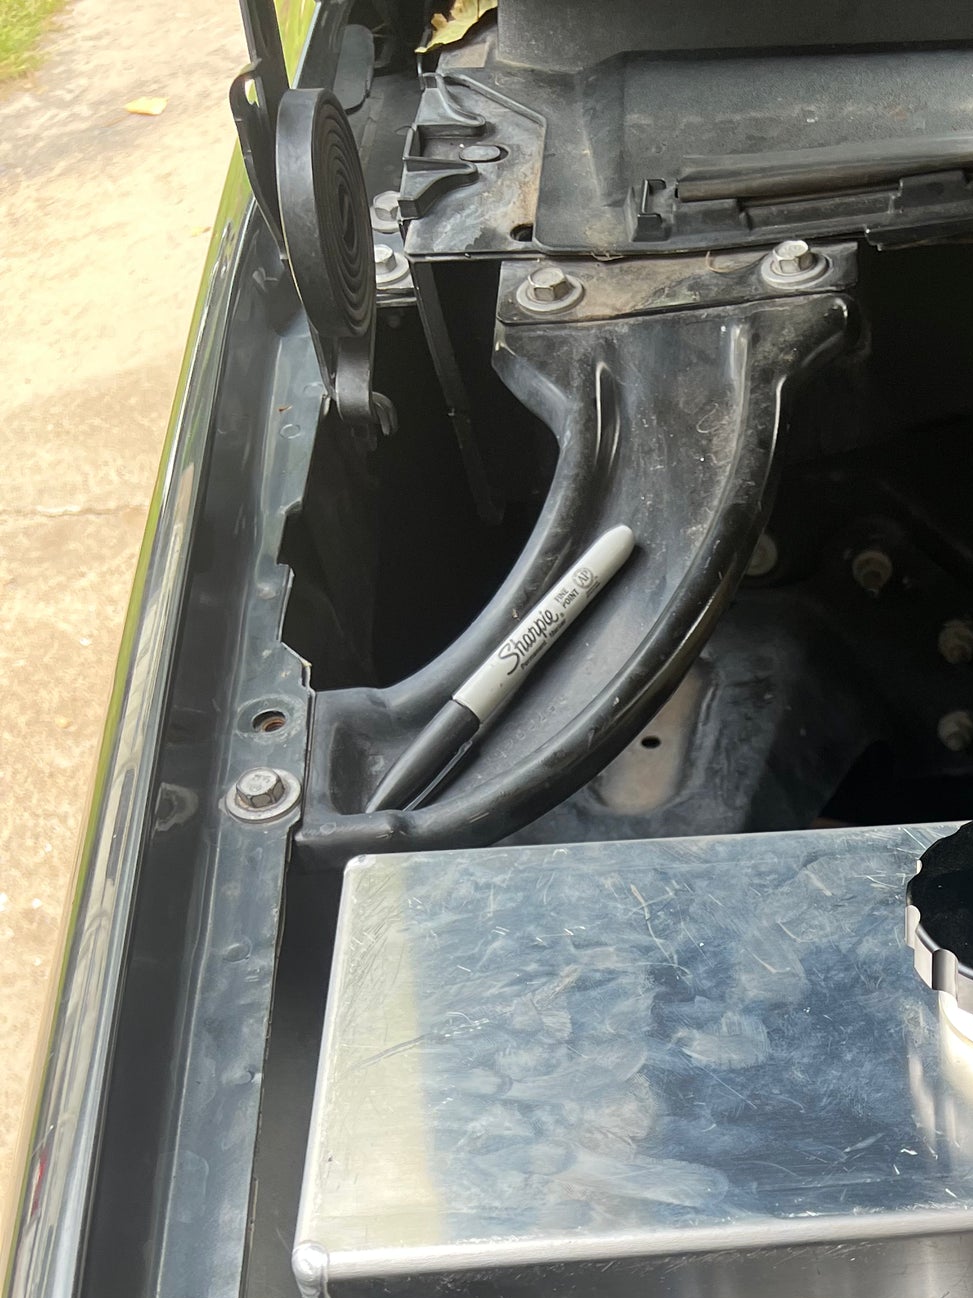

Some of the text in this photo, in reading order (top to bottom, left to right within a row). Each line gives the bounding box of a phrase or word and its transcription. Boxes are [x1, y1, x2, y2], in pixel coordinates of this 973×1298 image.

[554, 587, 570, 603] FINE
[563, 588, 580, 609] POINT
[498, 609, 560, 675] Sharpie
